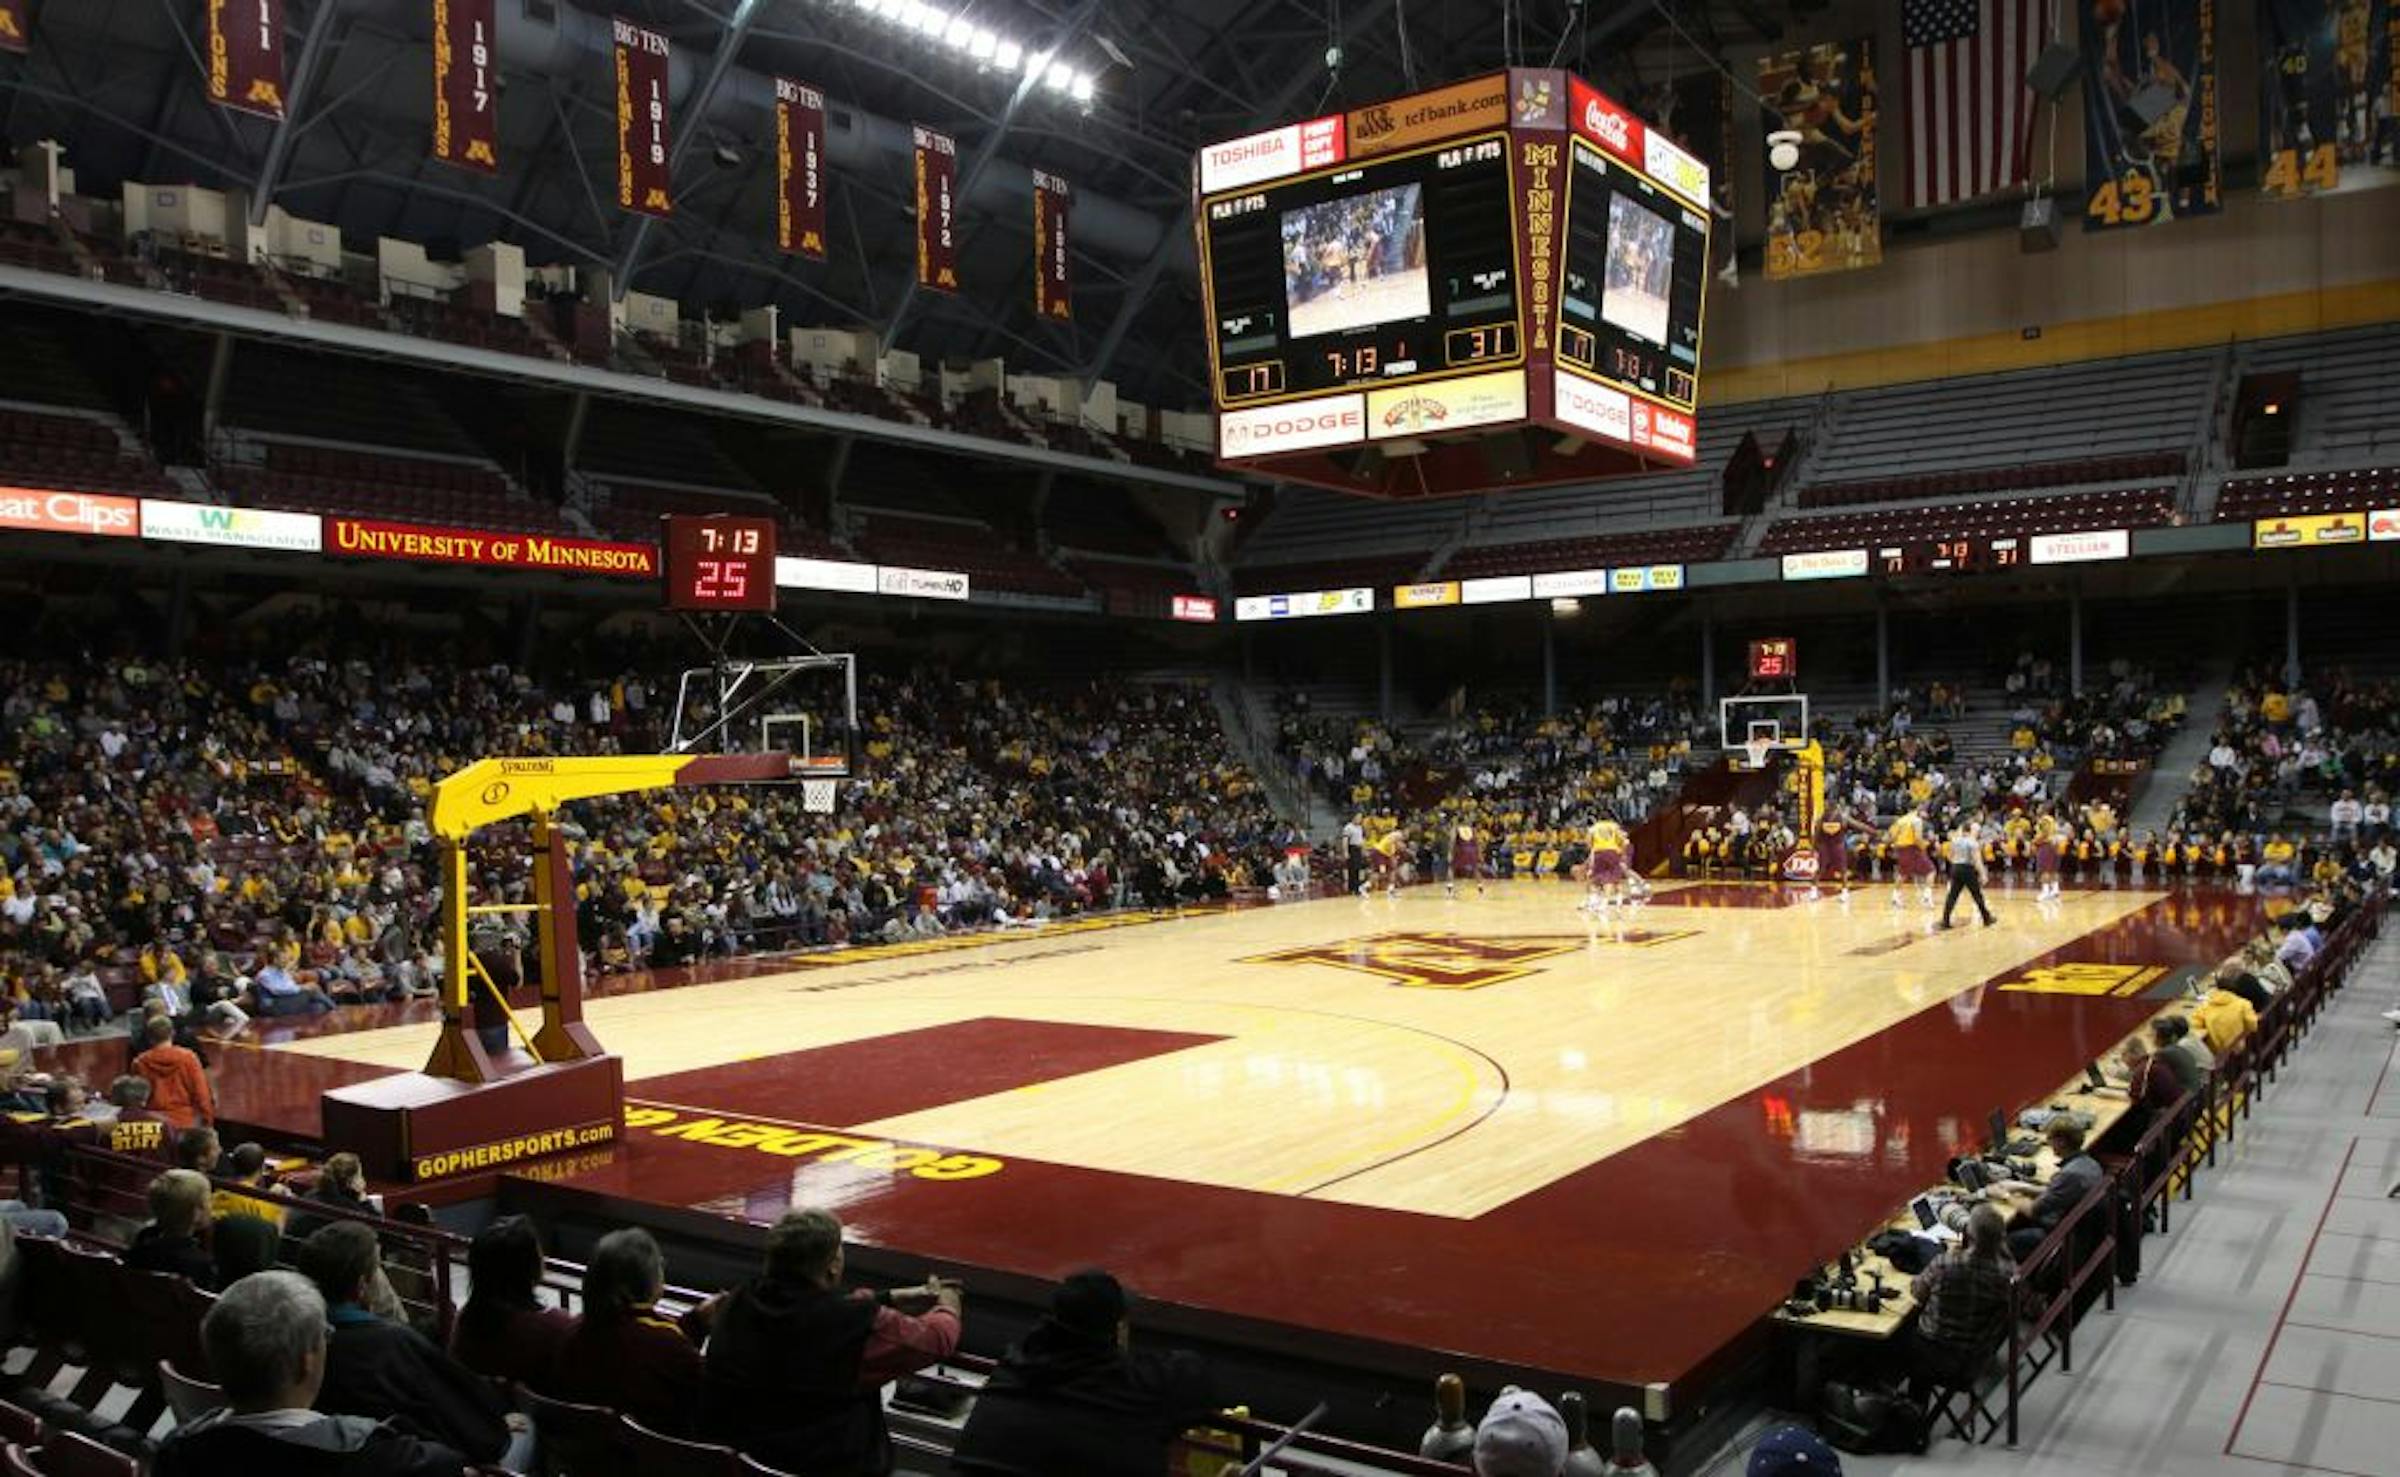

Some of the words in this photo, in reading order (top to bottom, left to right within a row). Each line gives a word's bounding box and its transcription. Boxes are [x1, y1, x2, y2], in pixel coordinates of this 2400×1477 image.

[613, 20, 639, 49] BIG
[639, 30, 669, 58] TEN
[471, 20, 489, 113] 1917
[775, 77, 798, 102] BIG
[798, 84, 825, 112] TEN
[615, 48, 634, 207] CHAMPIONS
[649, 79, 665, 165] 1919
[933, 133, 956, 157] TEN
[1211, 137, 1285, 168] TOSHIBA
[805, 131, 817, 209] 1937
[2261, 142, 2340, 202] 44
[940, 174, 952, 249] 1972
[2087, 173, 2154, 226] 43
[1524, 142, 1558, 349] MINNESOTA
[1327, 346, 1378, 378] 7:13
[1470, 328, 1502, 358] 31
[1249, 366, 1270, 394] 17
[1253, 411, 1360, 439] DODGE
[1571, 394, 1628, 426] DODGE
[0, 497, 41, 519] at
[46, 494, 130, 534] Clips
[336, 521, 485, 560] UNIVERSITY
[490, 540, 519, 562] OF
[526, 538, 652, 572] MINNESOTA
[701, 528, 760, 554] 7:13
[1997, 549, 2018, 565] 31
[694, 561, 747, 598] 25
[1758, 656, 1784, 675] 25
[418, 1123, 614, 1180] GOPHERSPORTS.com
[654, 1117, 1004, 1182] GOLDEN
